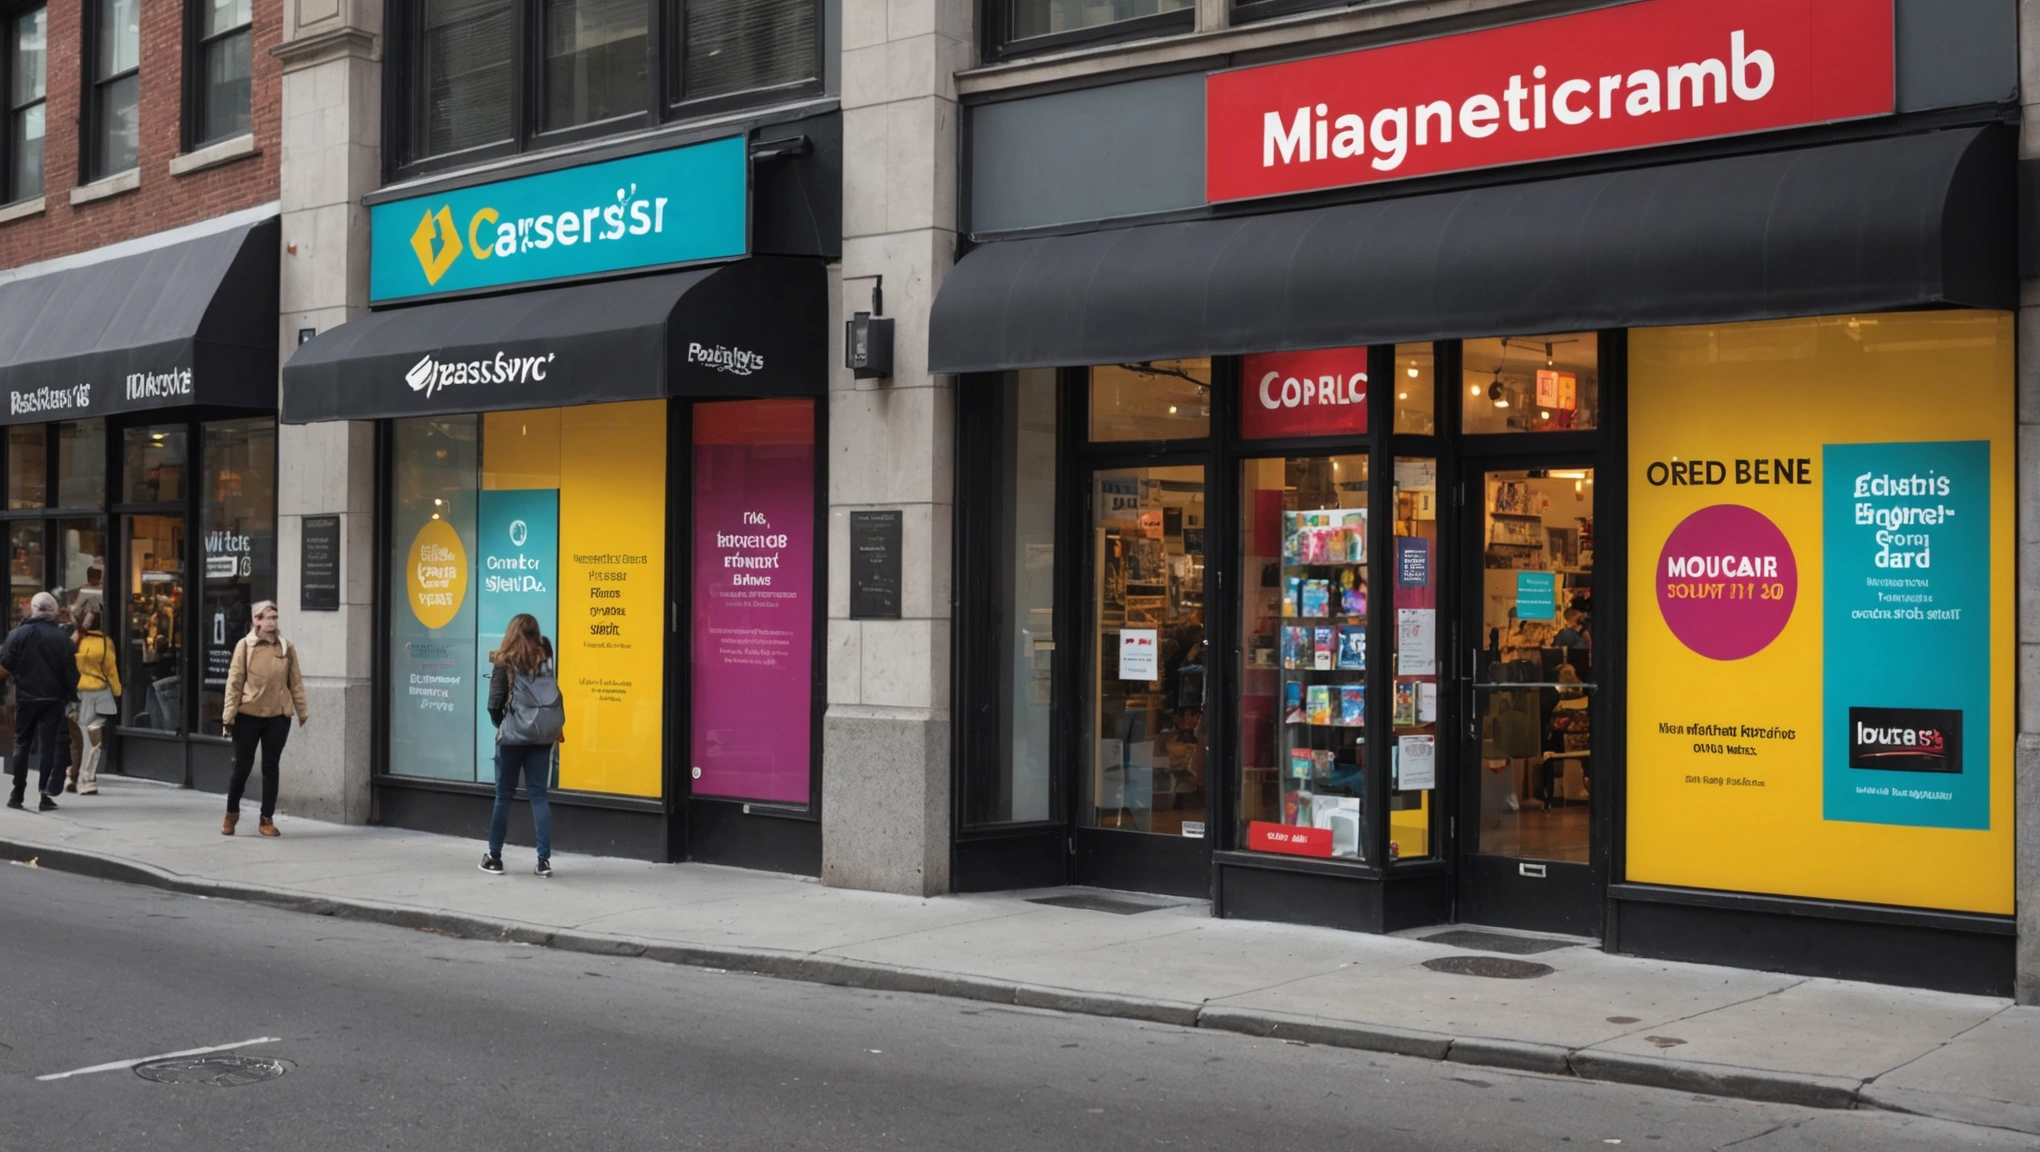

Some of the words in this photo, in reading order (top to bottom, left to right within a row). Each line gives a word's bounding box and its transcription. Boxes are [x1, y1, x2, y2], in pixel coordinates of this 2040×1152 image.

[1263, 29, 1775, 171] Miagneticramb
[1646, 460, 1727, 486] ORED
[1735, 458, 1812, 485] BENE
[1667, 556, 1778, 578] MOUCAIR
